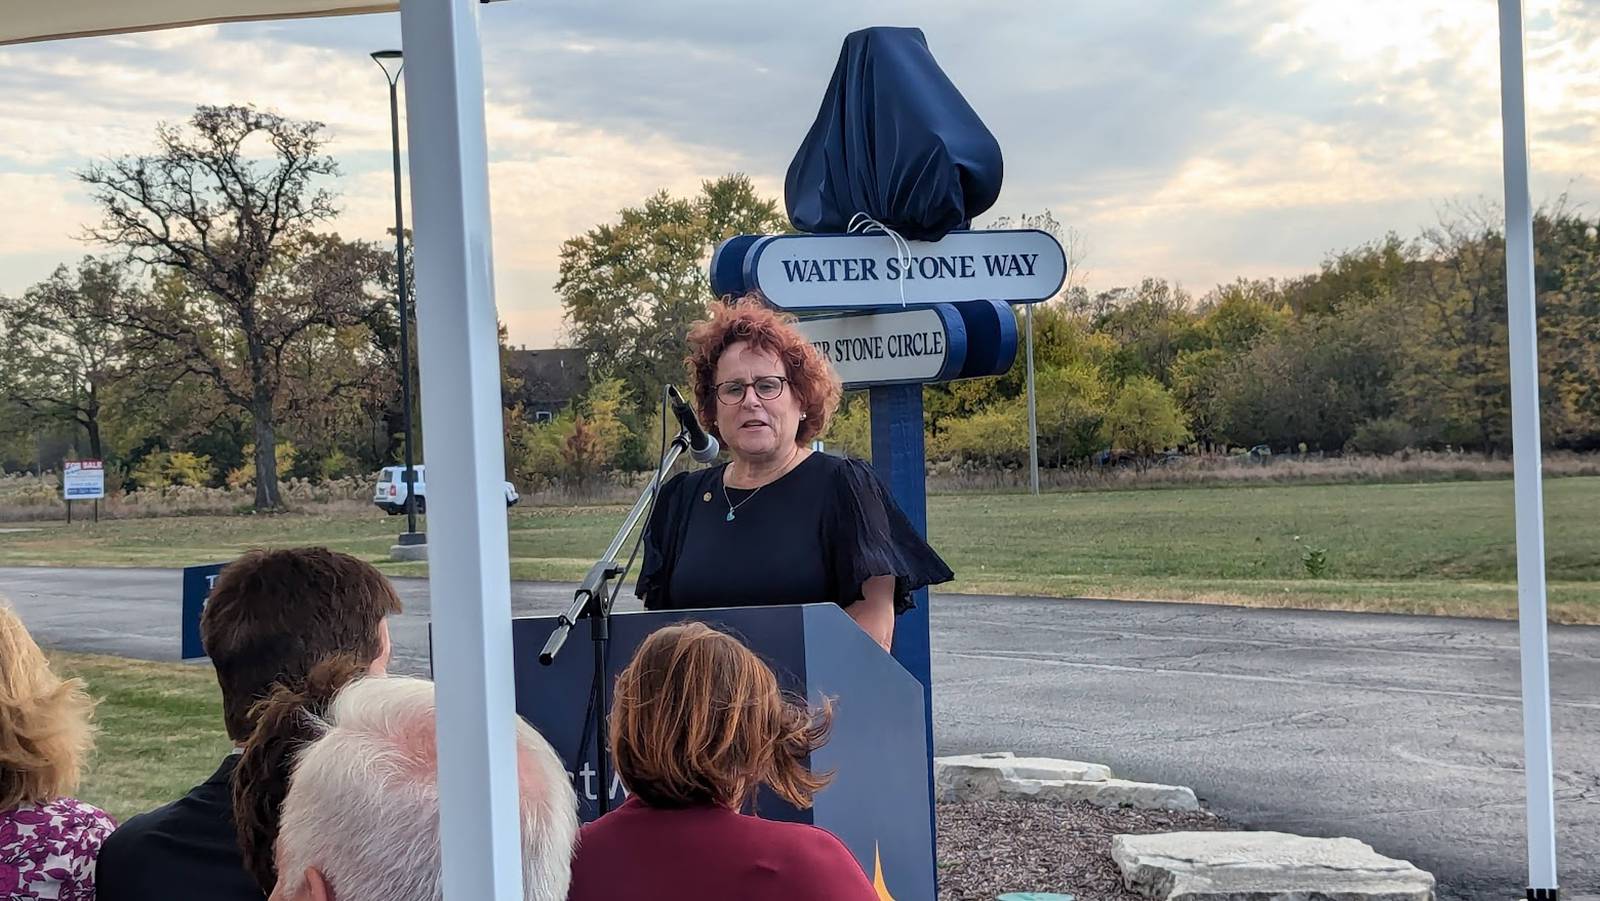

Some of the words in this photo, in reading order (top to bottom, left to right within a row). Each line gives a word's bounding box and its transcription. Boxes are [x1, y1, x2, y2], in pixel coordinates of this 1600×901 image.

[781, 258, 879, 283] WATER
[886, 255, 975, 281] STONE
[982, 253, 1039, 277] WAY
[835, 337, 883, 362] STONE
[888, 331, 943, 358] CIRCLE
